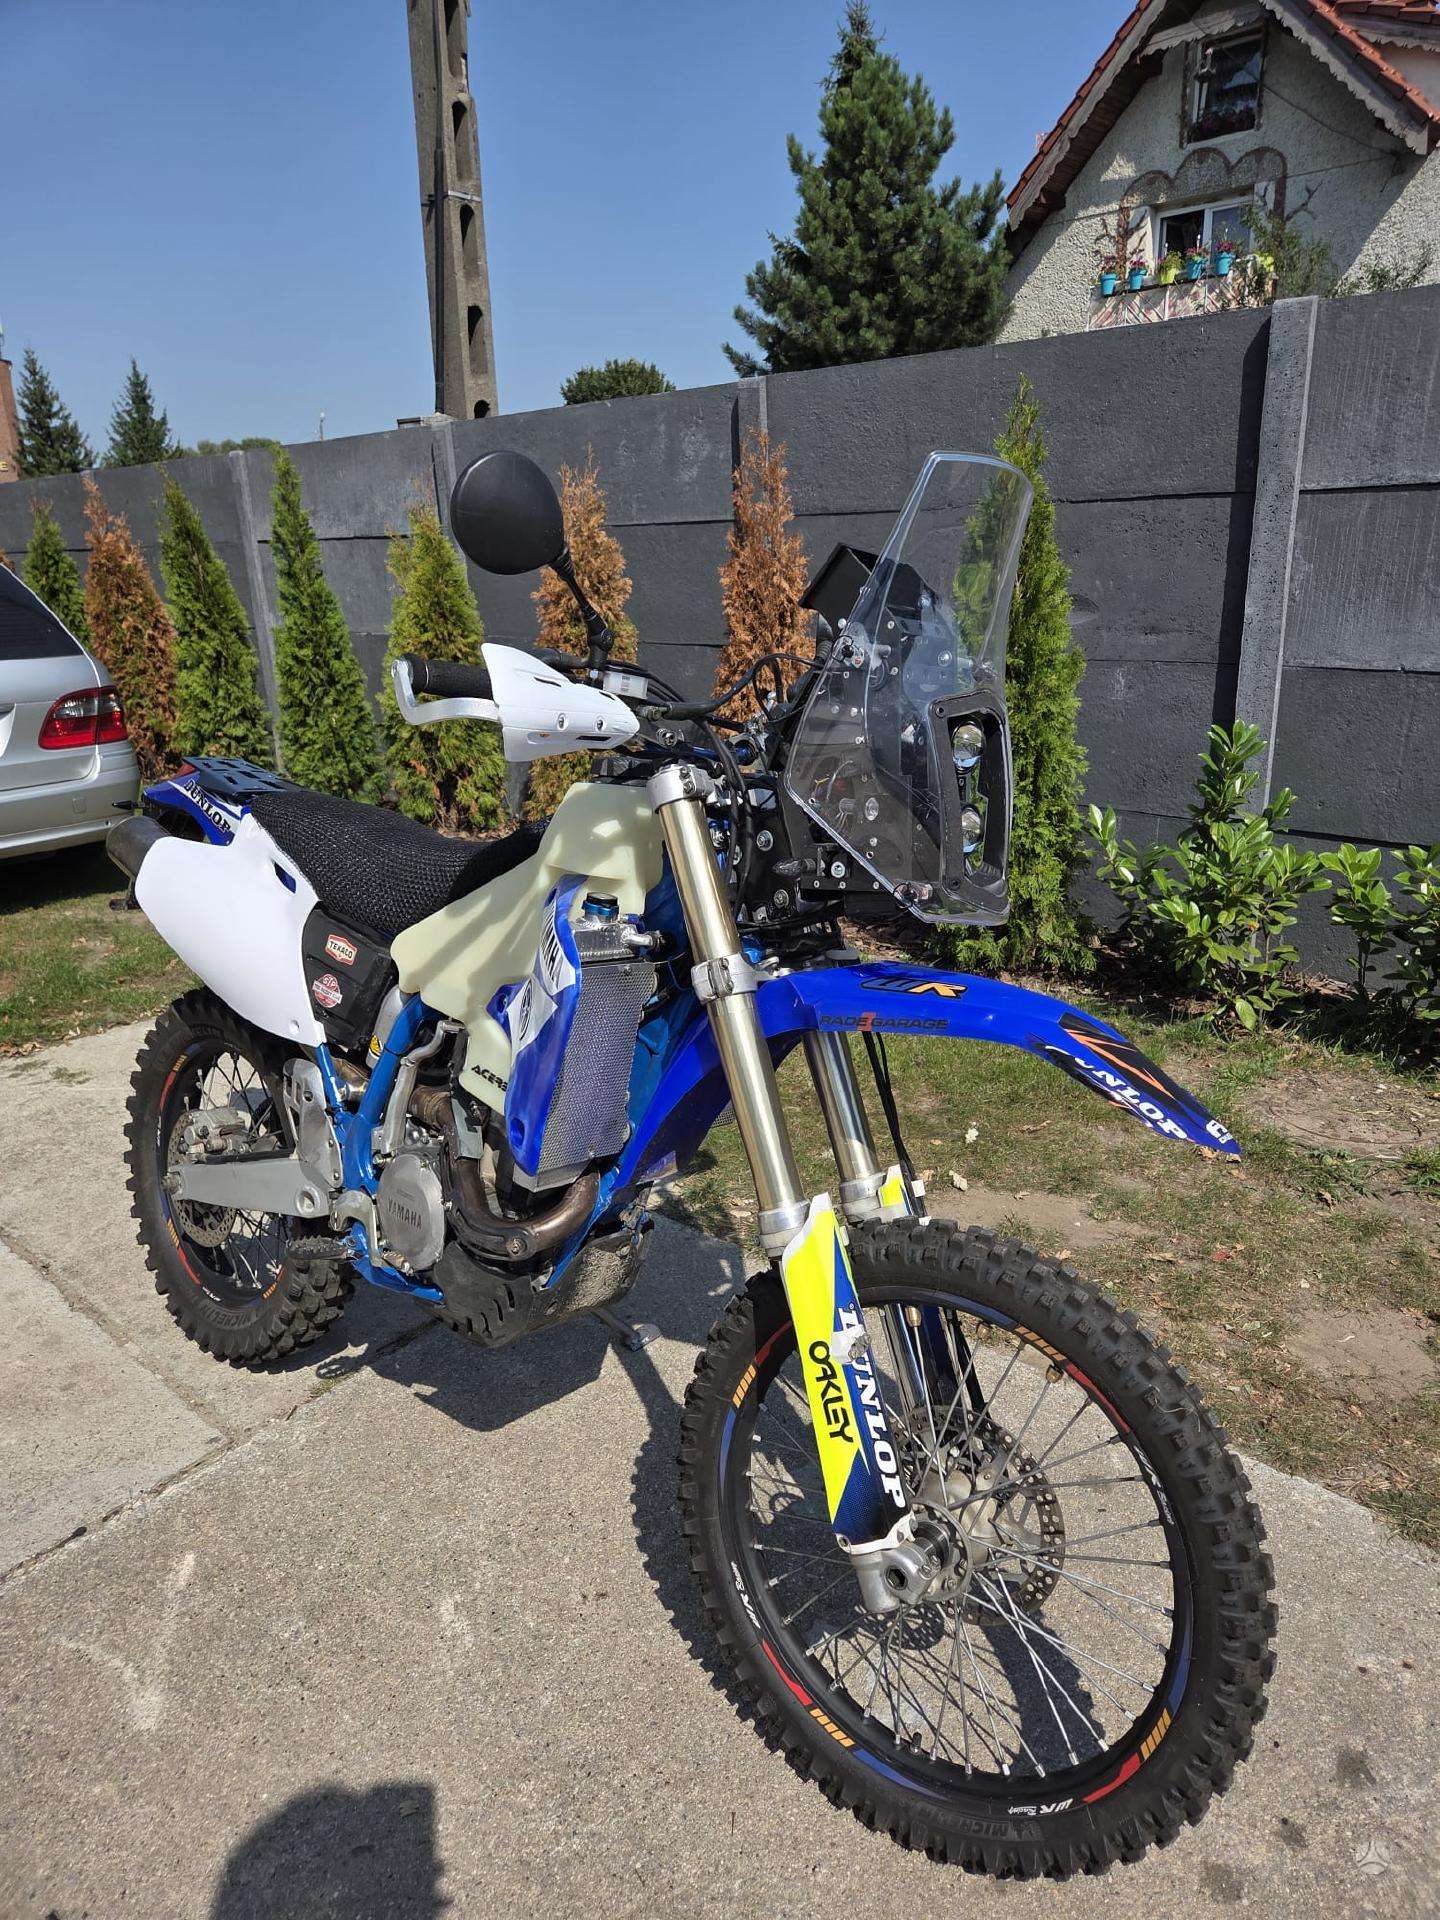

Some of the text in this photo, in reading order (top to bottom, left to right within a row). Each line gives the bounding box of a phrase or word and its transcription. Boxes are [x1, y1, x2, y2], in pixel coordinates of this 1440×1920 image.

[184, 779, 231, 832] DUNLOP
[329, 940, 353, 959] TEXACO
[871, 1017, 948, 1030] GARAGE
[388, 1196, 422, 1230] YAMAHA
[808, 1340, 854, 1443] OAKLEY
